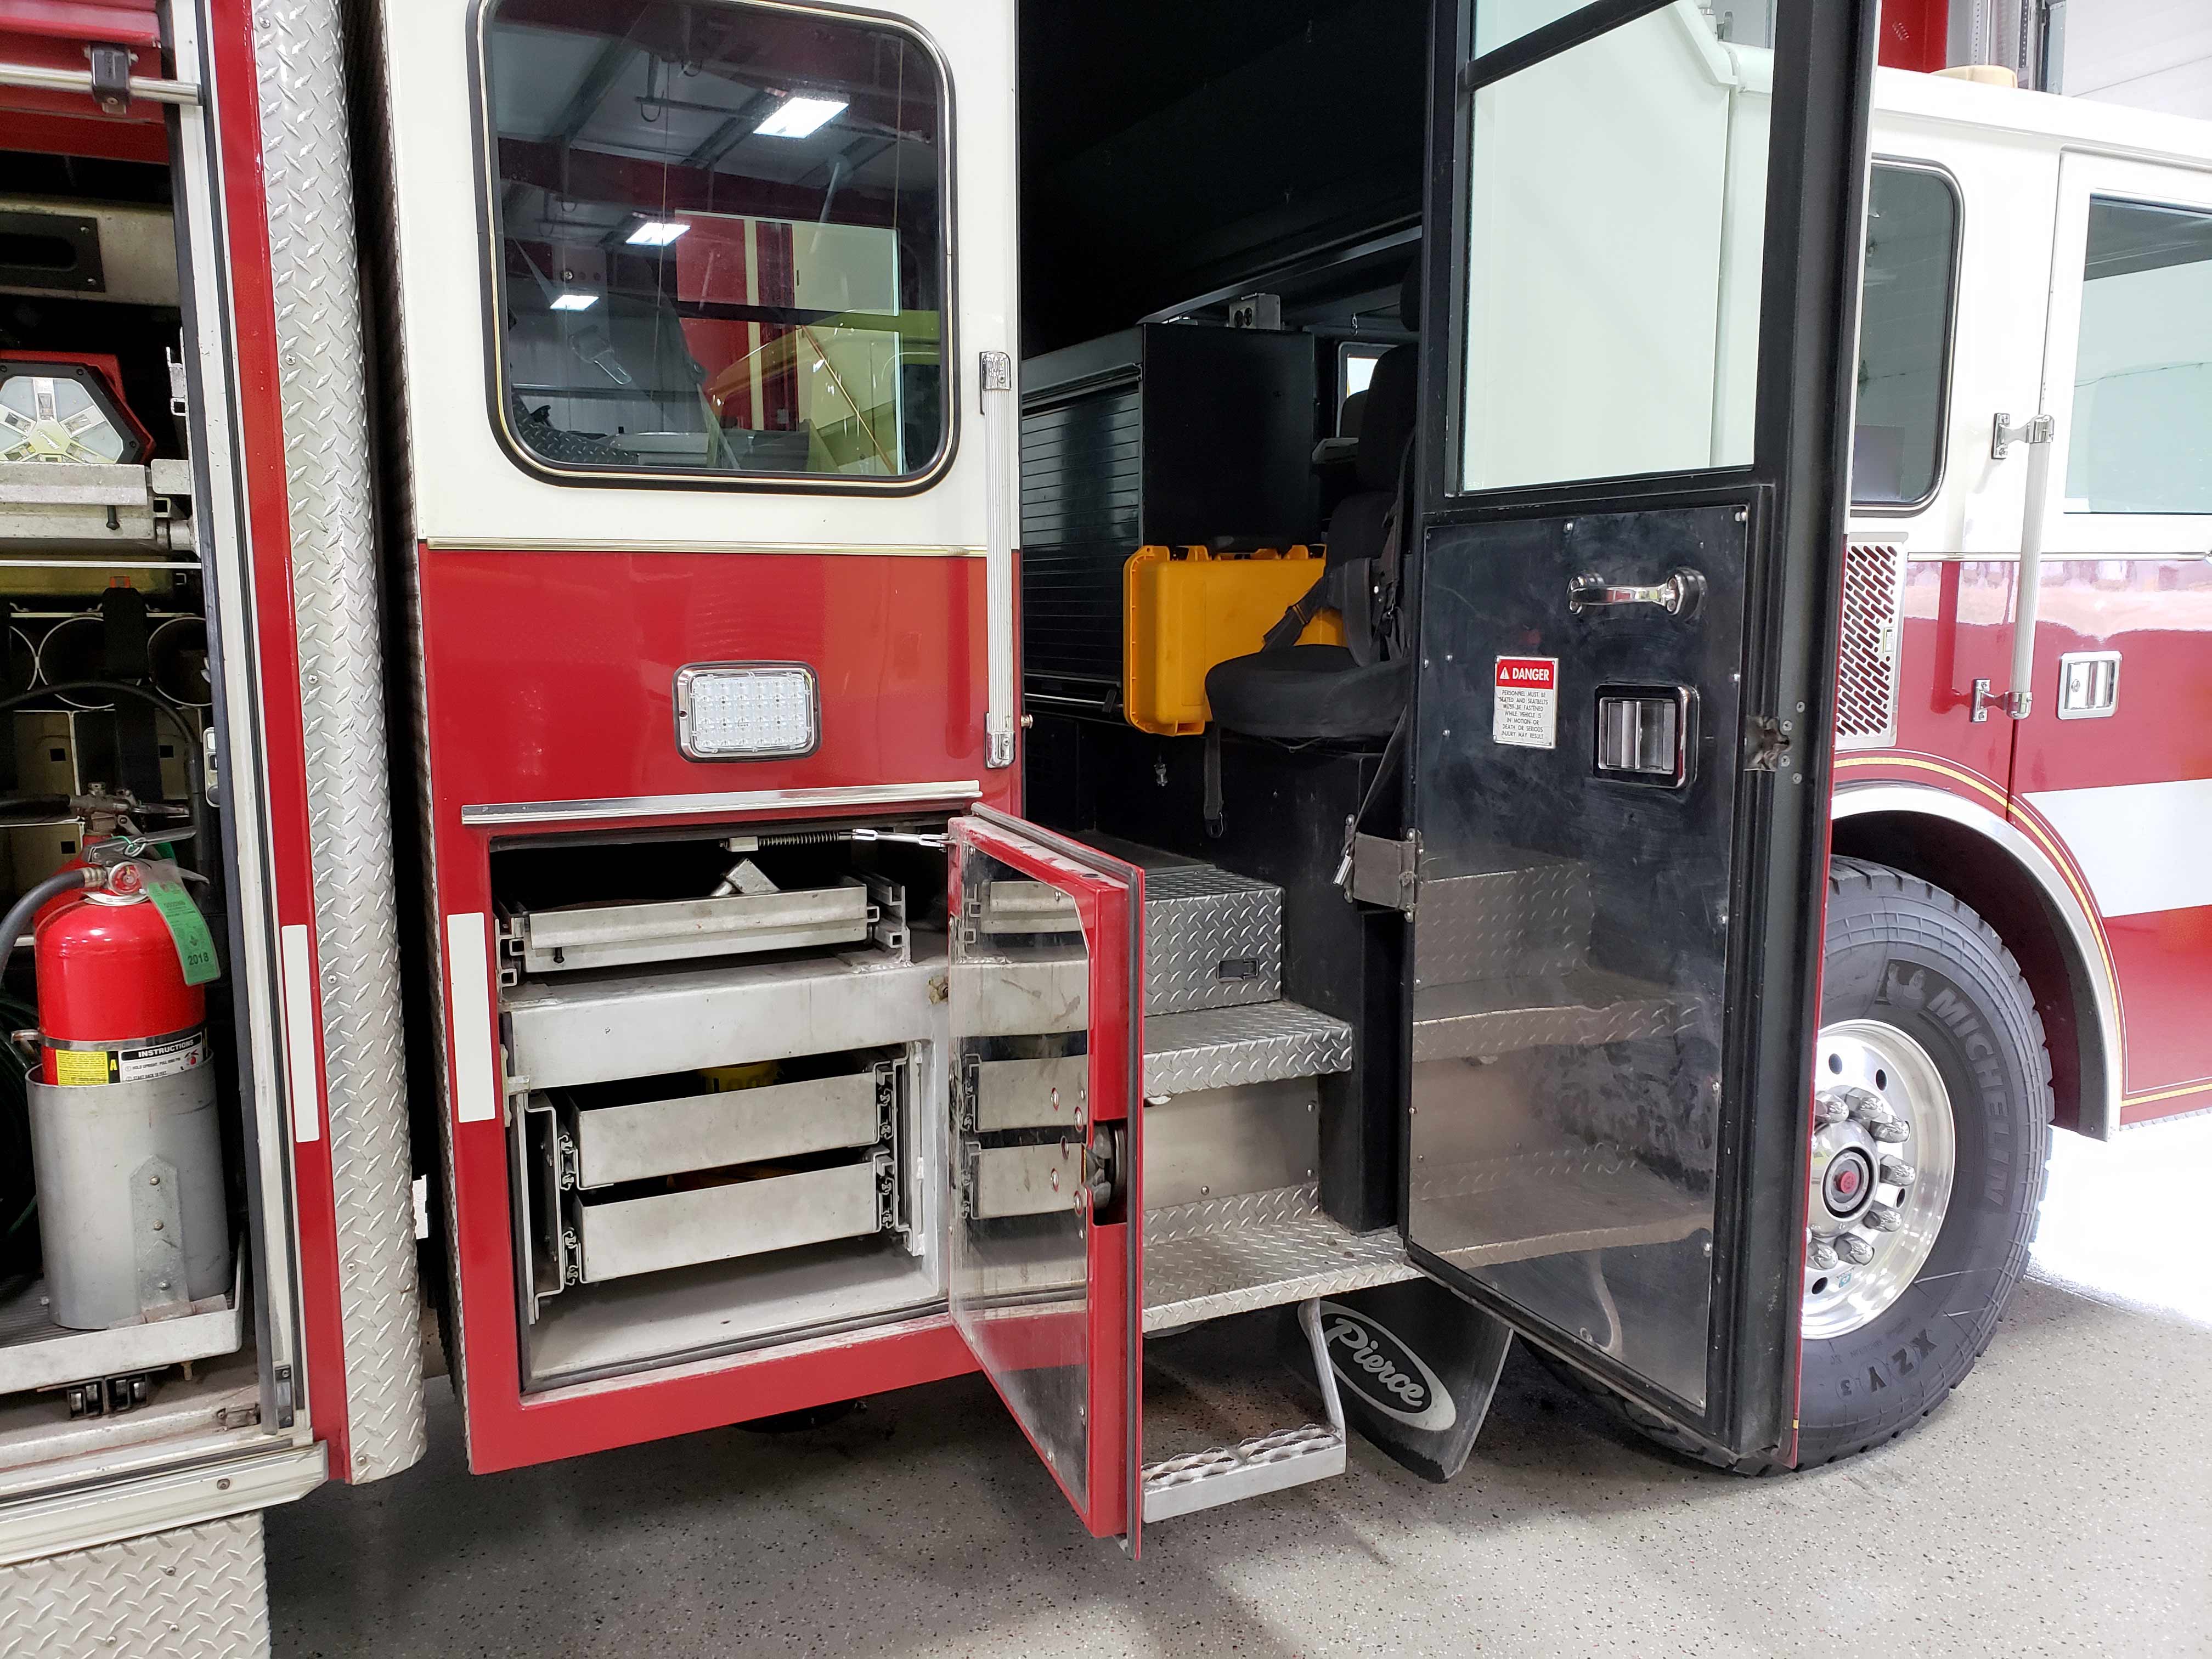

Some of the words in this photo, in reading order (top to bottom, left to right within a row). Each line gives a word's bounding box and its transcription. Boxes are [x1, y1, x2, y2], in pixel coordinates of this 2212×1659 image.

[1512, 667, 1550, 681] DANGER
[188, 952, 210, 966] 2018
[138, 1039, 194, 1058] INSTRUCTIONS
[110, 1059, 117, 1071] A
[1926, 988, 2012, 1207] MICHELIN
[1323, 1317, 1425, 1407] Pierce
